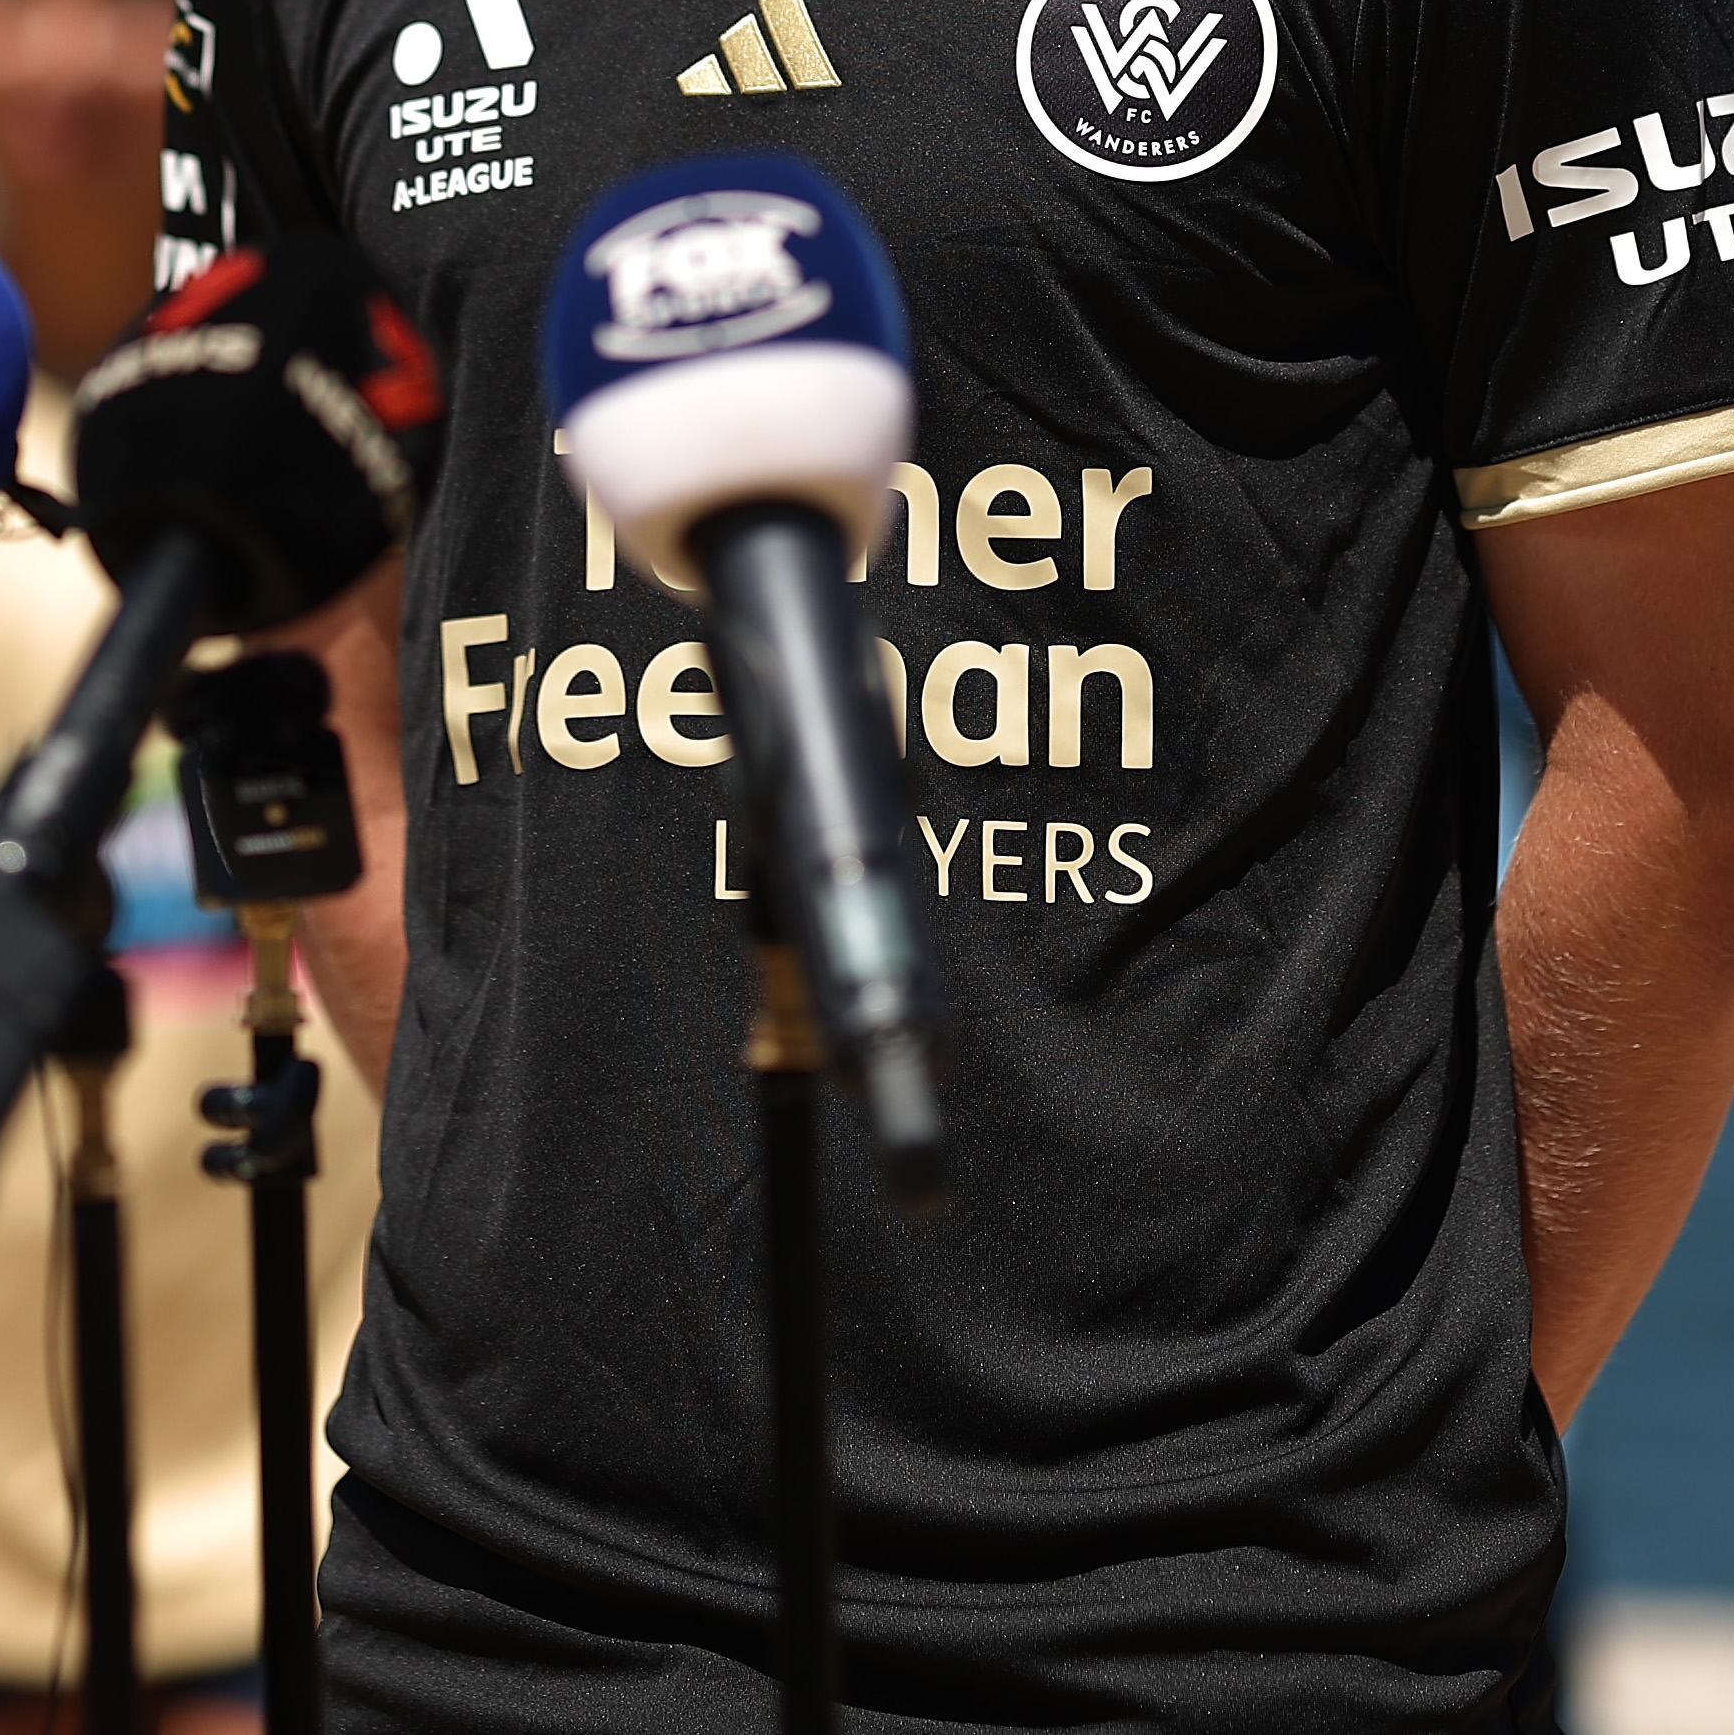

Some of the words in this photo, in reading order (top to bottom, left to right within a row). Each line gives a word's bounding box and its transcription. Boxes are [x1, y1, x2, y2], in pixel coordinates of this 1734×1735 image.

[390, 80, 538, 140] ISUZU
[1126, 108, 1153, 124] FC
[415, 125, 504, 164] UTE
[1075, 117, 1200, 157] WANDERERS
[714, 817, 1154, 904] LYERS
